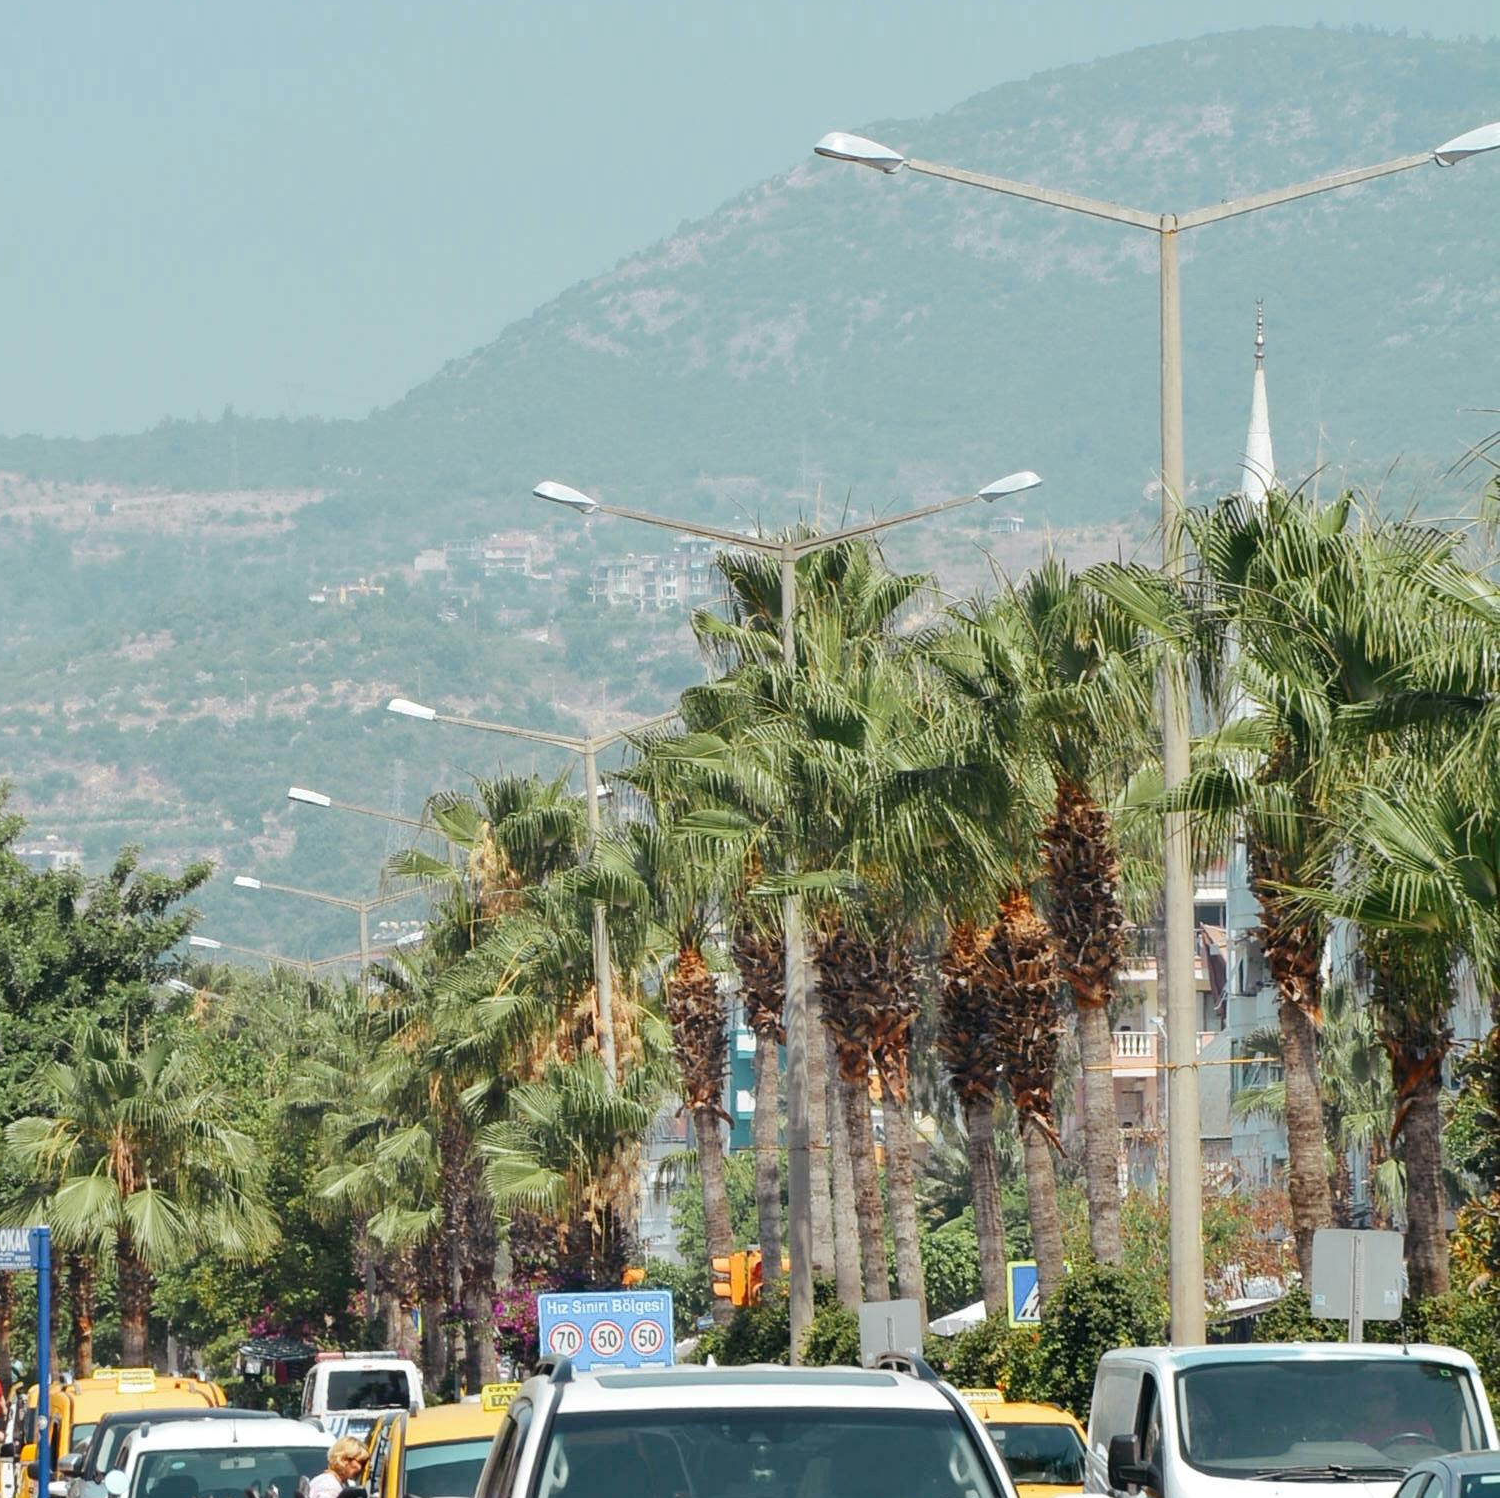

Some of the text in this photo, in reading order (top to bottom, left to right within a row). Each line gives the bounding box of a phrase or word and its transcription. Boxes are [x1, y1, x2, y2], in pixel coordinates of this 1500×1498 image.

[547, 1298, 665, 1316] Hız Sınırı Bölgesi
[556, 1332, 576, 1350] 70
[598, 1330, 617, 1348] 50
[638, 1329, 657, 1347] 50
